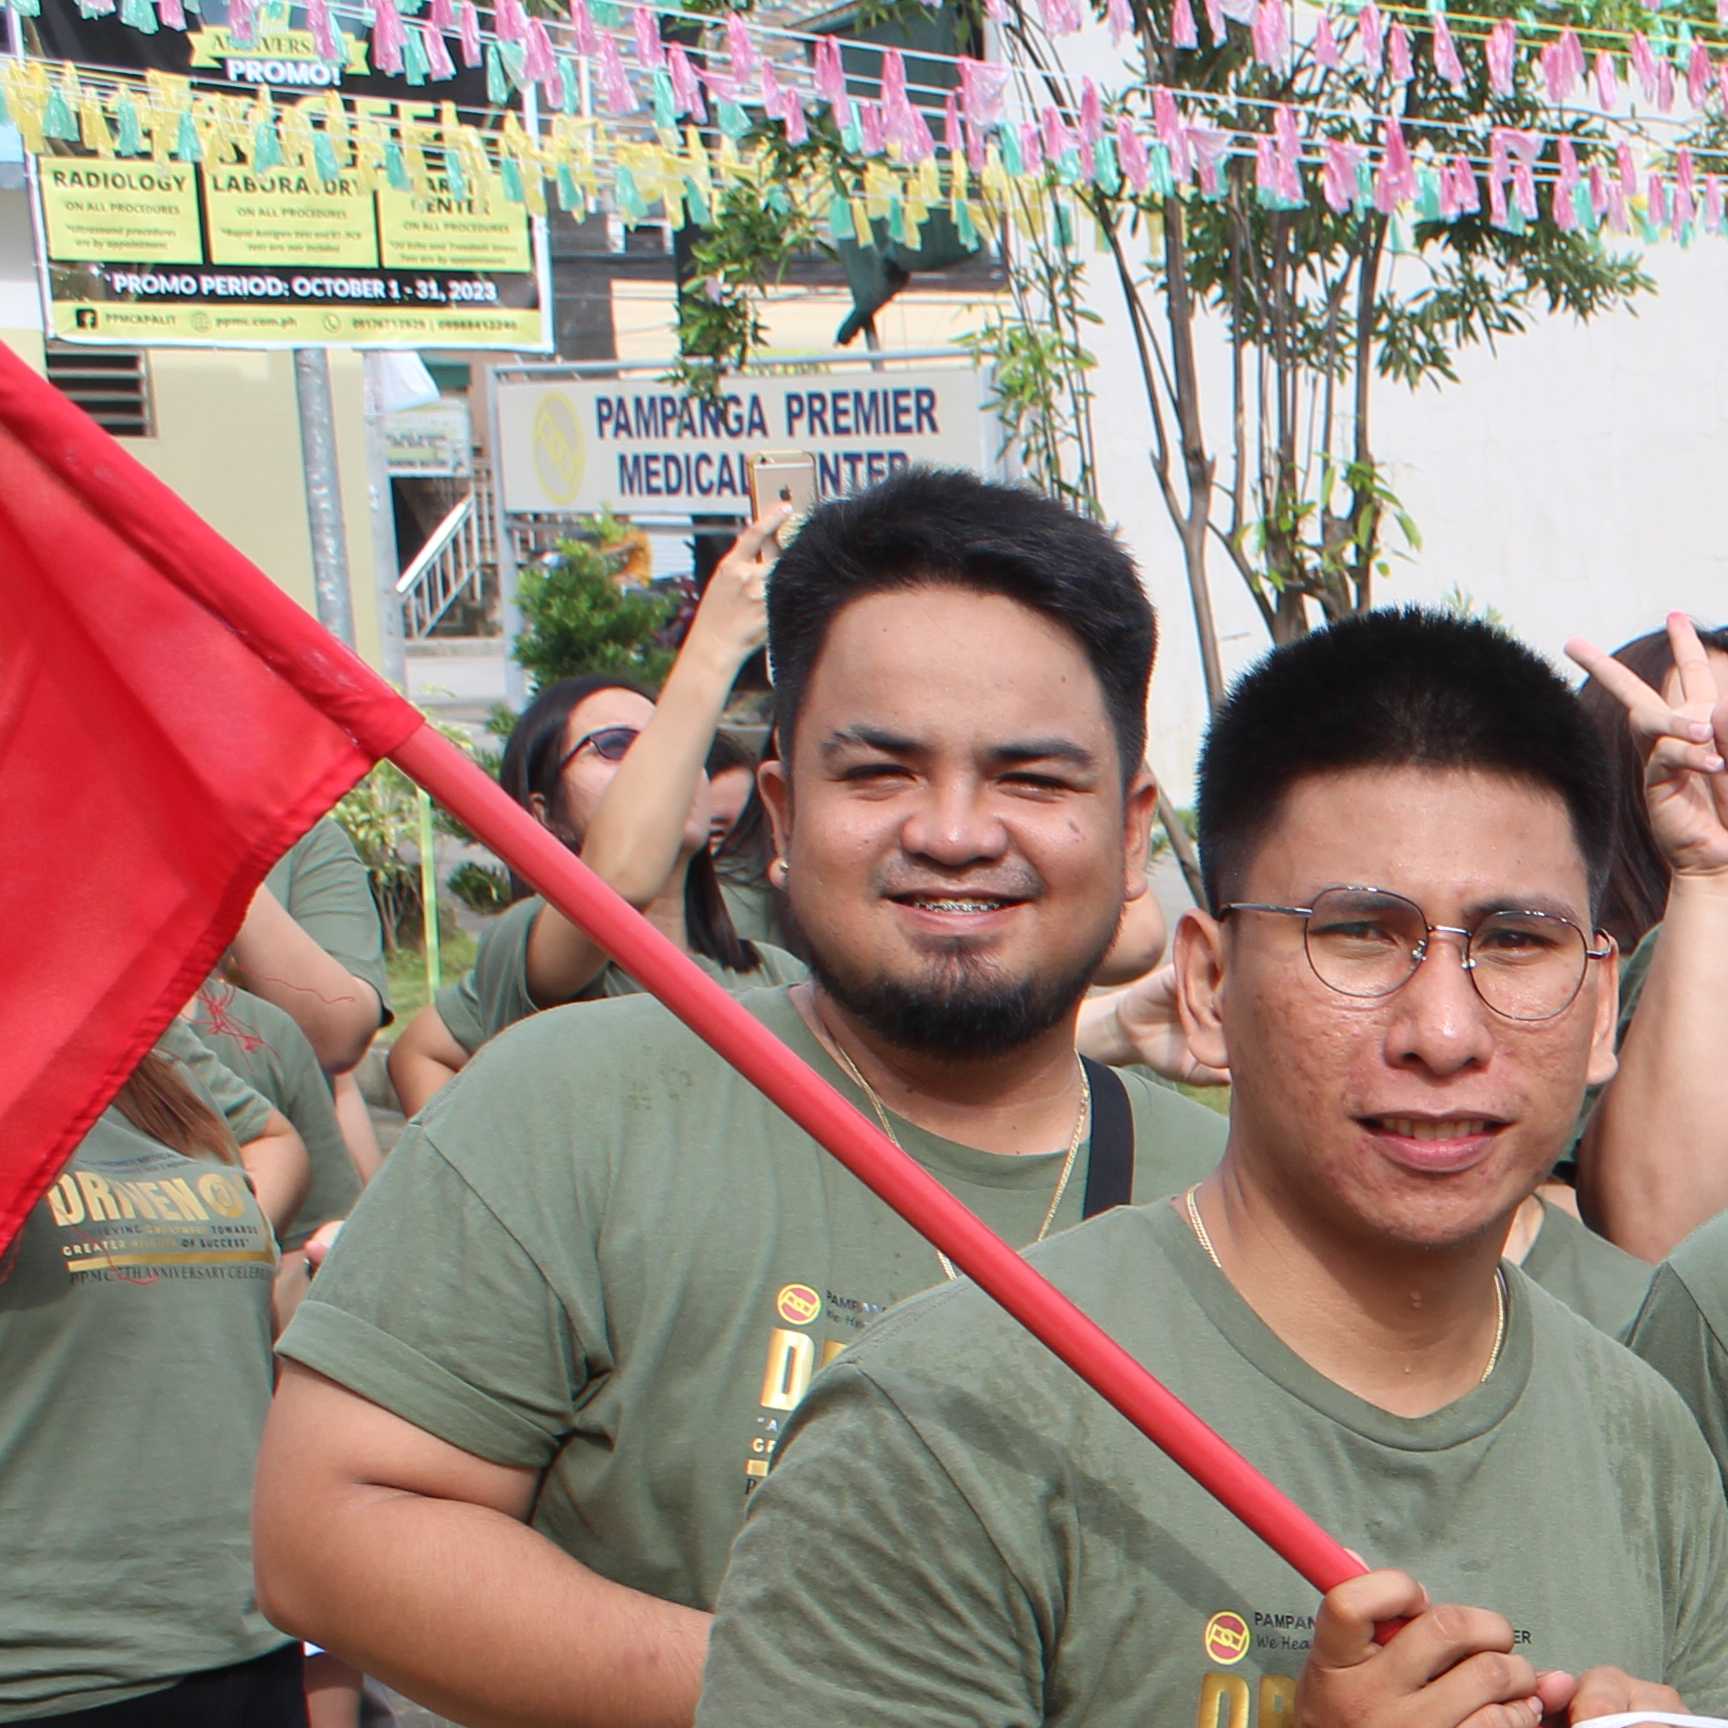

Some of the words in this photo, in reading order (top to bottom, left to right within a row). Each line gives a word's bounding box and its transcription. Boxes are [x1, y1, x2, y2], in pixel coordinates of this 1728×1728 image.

[227, 57, 342, 86] PROMO!
[52, 169, 188, 193] RADIOLOGY
[211, 173, 361, 197] LABORAORY
[65, 199, 86, 212] ON
[88, 201, 106, 213] ALL
[110, 202, 181, 216] PROCEDURES
[236, 206, 256, 218] ON
[259, 207, 278, 218] ALL
[281, 208, 347, 219] PROCEDURES
[403, 221, 420, 232] ON
[422, 222, 440, 233] ALL
[443, 223, 510, 234] PROCEDURES
[112, 273, 198, 295] PROMO
[200, 275, 290, 297] PERIOD:
[291, 276, 386, 299] OCTOBER
[388, 279, 400, 299] 1
[414, 279, 446, 302] 31,
[449, 281, 498, 301] 2023
[597, 392, 769, 441] PAMPANGA
[785, 388, 939, 436] PREMIER
[618, 451, 749, 496] MEDICAL
[145, 1263, 225, 1281] ANNIVERSARY
[1254, 1612, 1316, 1630] PAMPAN
[1257, 1634, 1279, 1648] We
[1281, 1635, 1310, 1651] Hea
